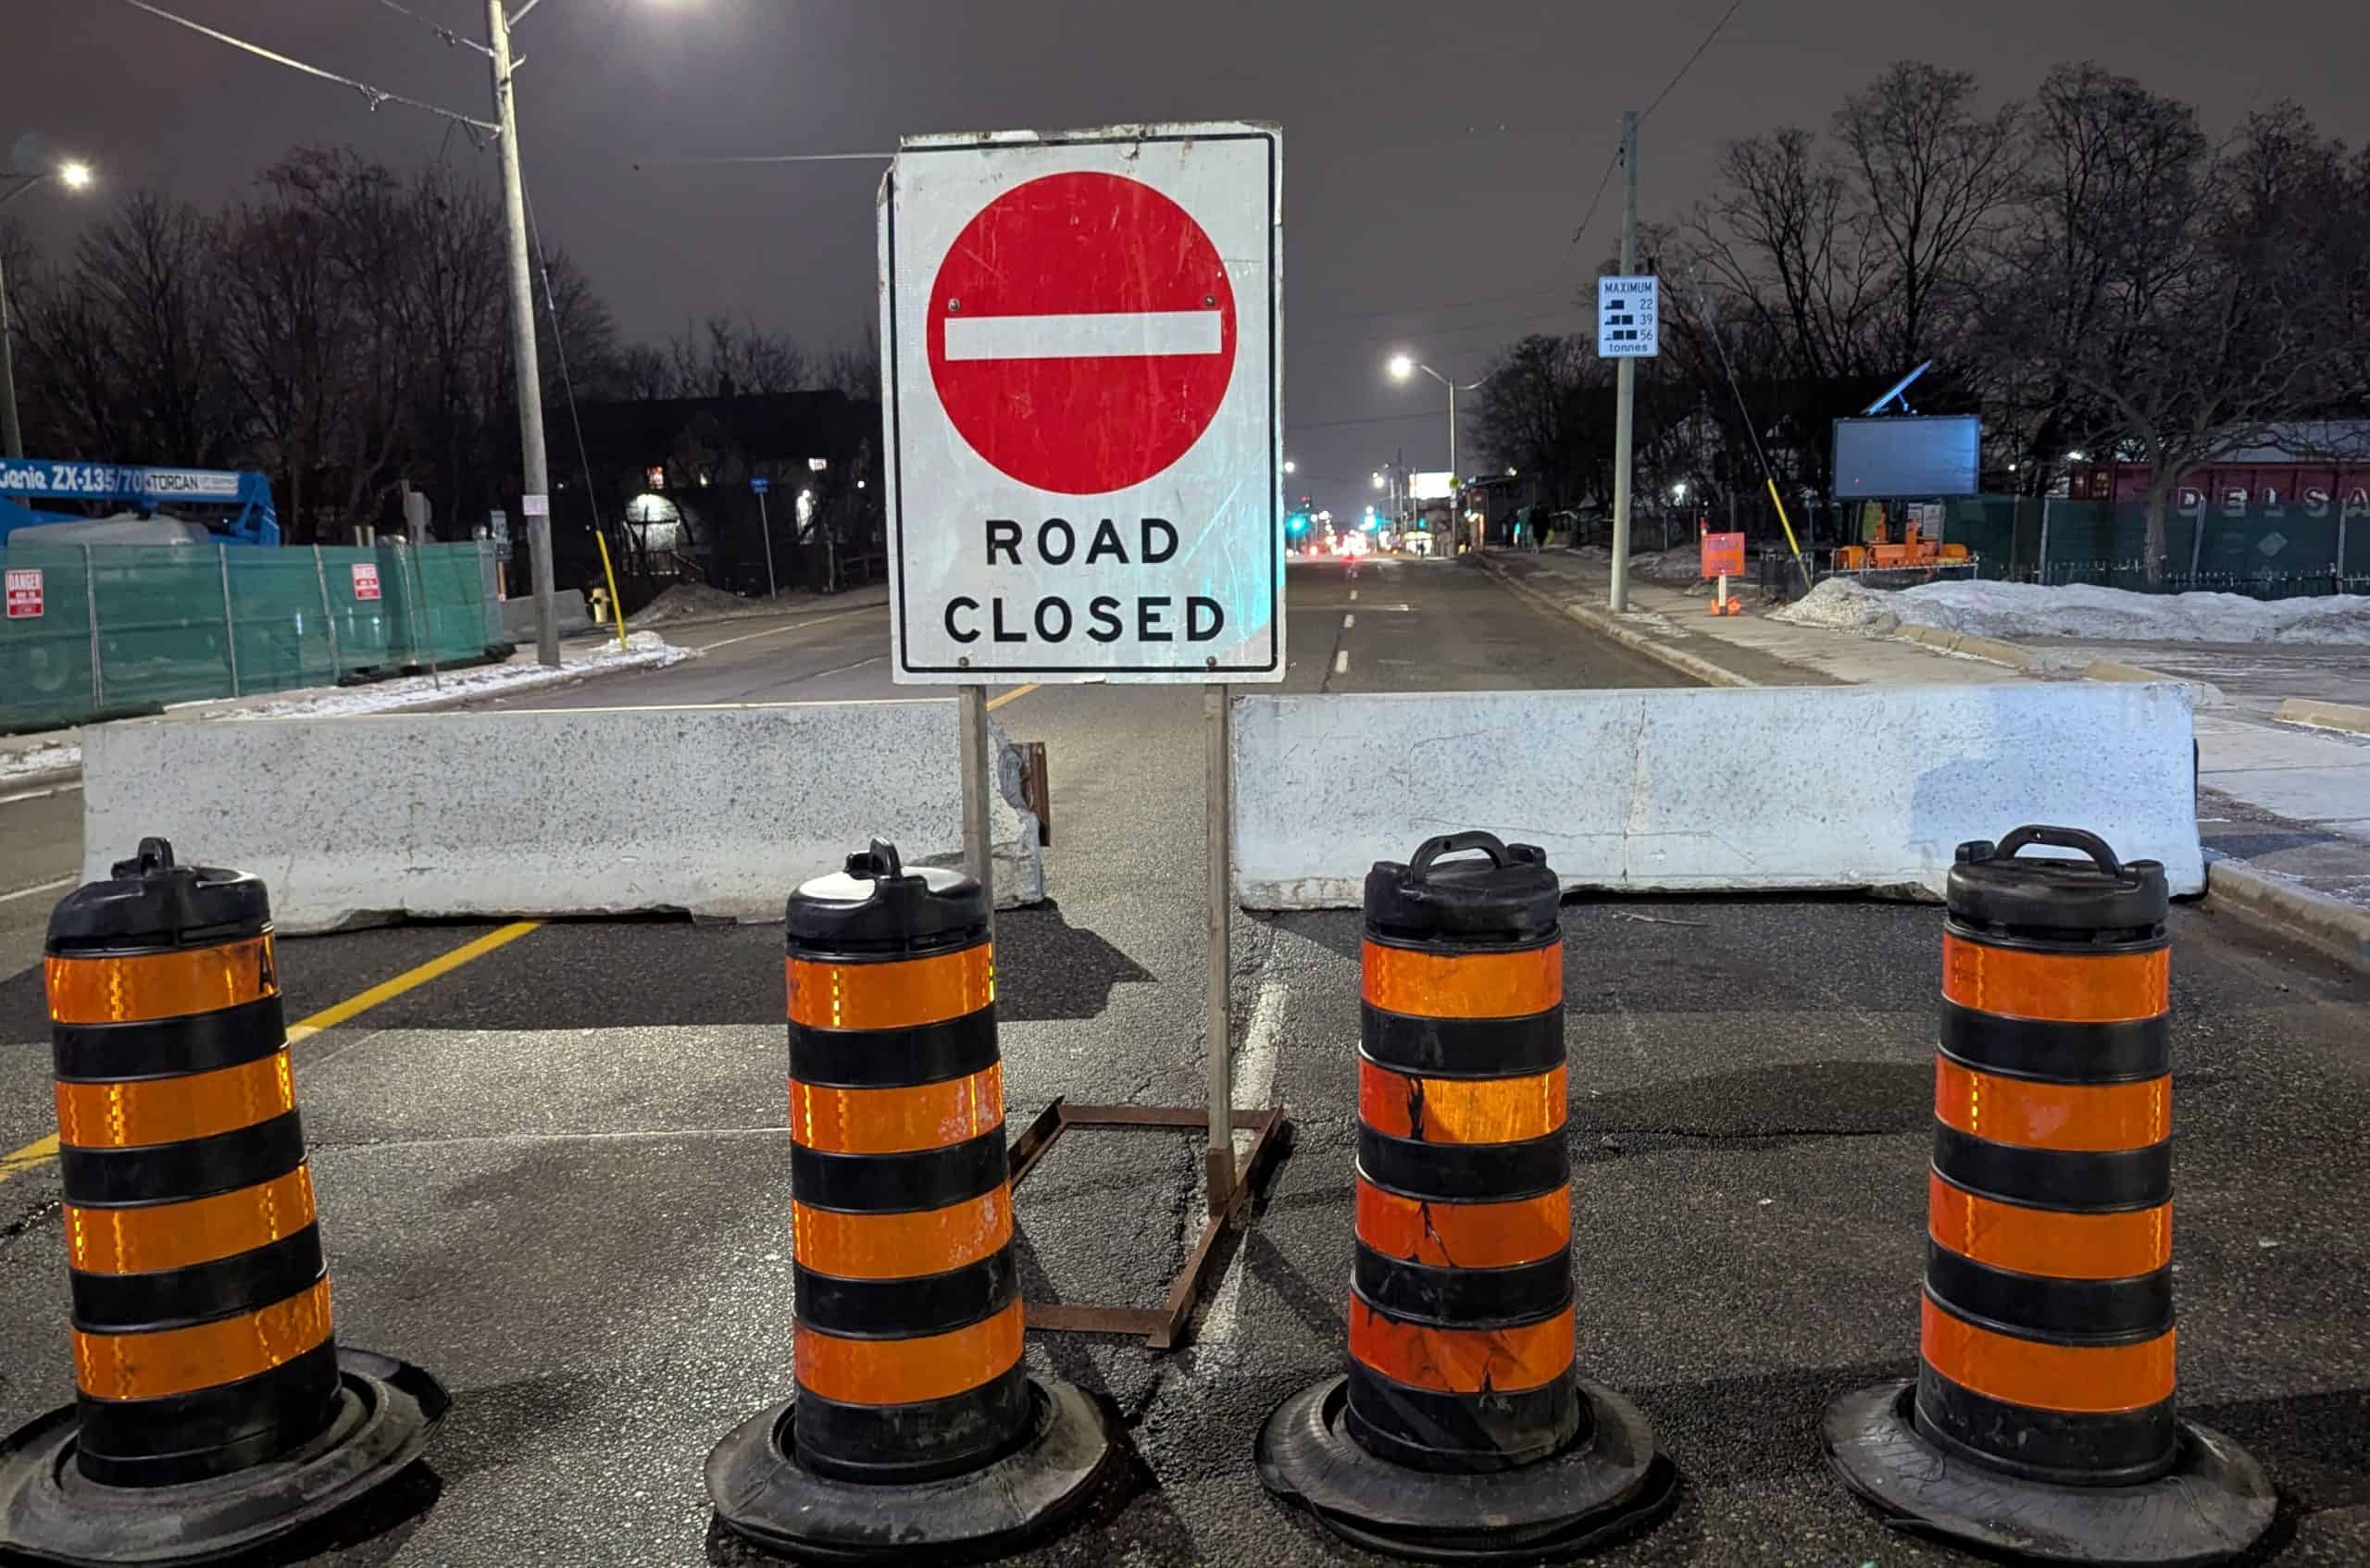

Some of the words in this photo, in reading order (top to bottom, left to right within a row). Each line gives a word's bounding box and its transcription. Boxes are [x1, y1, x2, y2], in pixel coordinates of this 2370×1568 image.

[1604, 281, 1652, 293] MAXIMUM
[1640, 299, 1653, 310] 22
[1640, 315, 1653, 325] 39
[1640, 330, 1653, 341] 56
[1609, 343, 1648, 352] tonnes
[986, 518, 1179, 566] ROAD
[944, 596, 1225, 643] CLOSED
